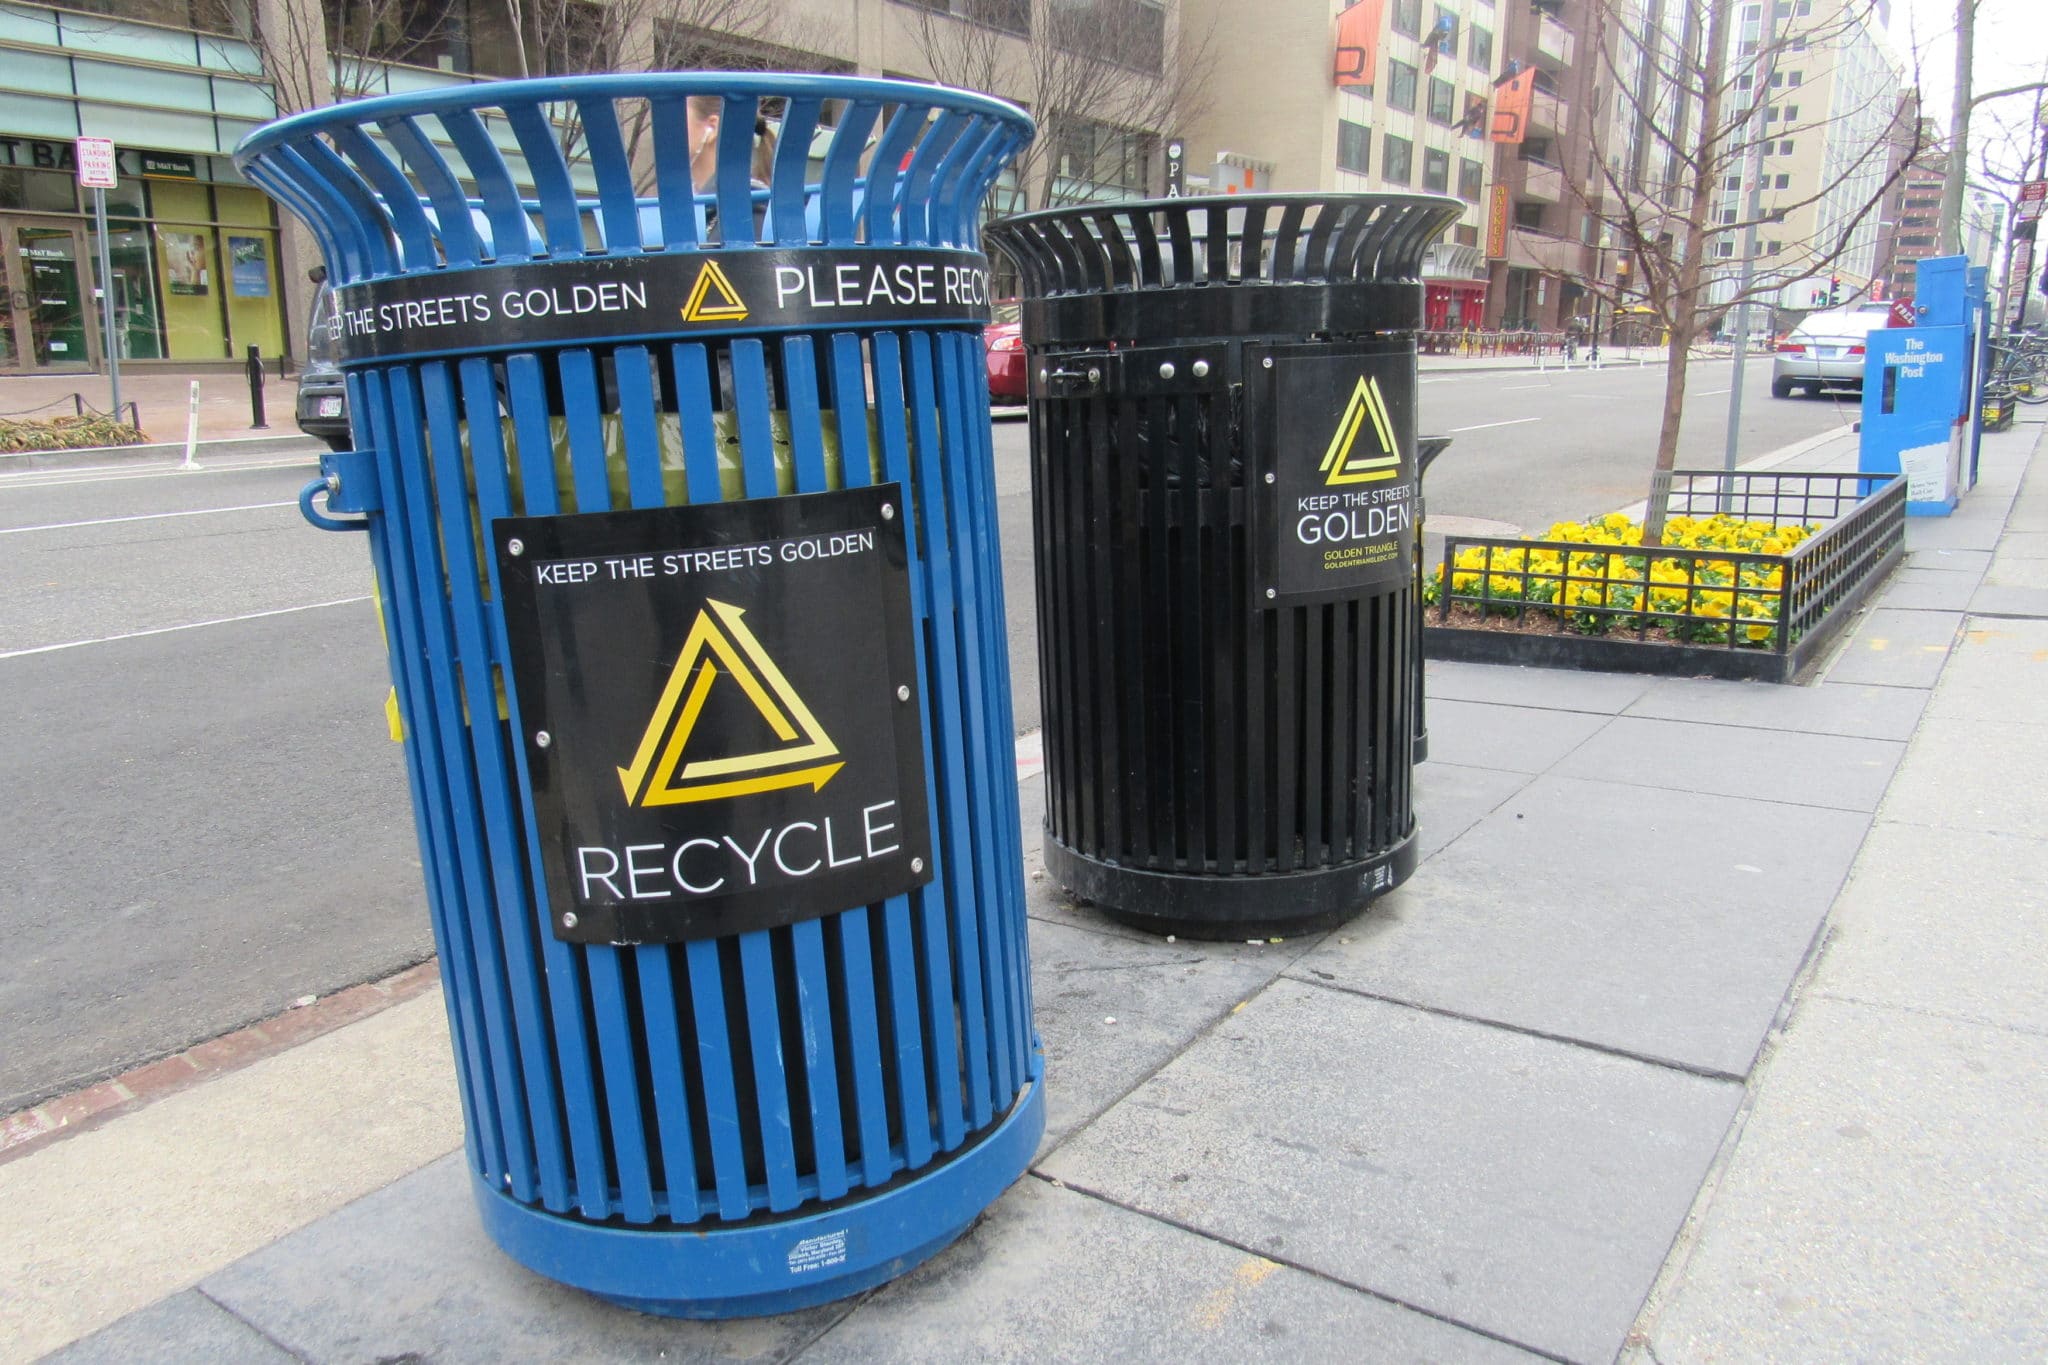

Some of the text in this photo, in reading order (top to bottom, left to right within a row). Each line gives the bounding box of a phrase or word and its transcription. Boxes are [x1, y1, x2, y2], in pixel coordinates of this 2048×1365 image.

[83, 160, 112, 169] PARKING
[156, 162, 190, 171] M&T Bank
[775, 264, 937, 309] PLEASE
[345, 308, 376, 336] THE
[380, 294, 491, 332] STREETS
[501, 281, 647, 317] GOLDEN
[1905, 338, 1924, 350] The
[1885, 352, 1943, 365] Washington
[1901, 366, 1924, 378] Post
[1298, 485, 1410, 512] KEEP THE STREETS
[1296, 501, 1410, 545] GOLDEN
[537, 532, 874, 585] KEEP THE STREETS GOLDEN
[1324, 541, 1398, 561] GOLDEN TRIANGLE
[1324, 552, 1398, 570] GOLDENTRIANGLEDC.COM
[578, 800, 900, 899] RECYCLE
[790, 1264, 802, 1273] Toll
